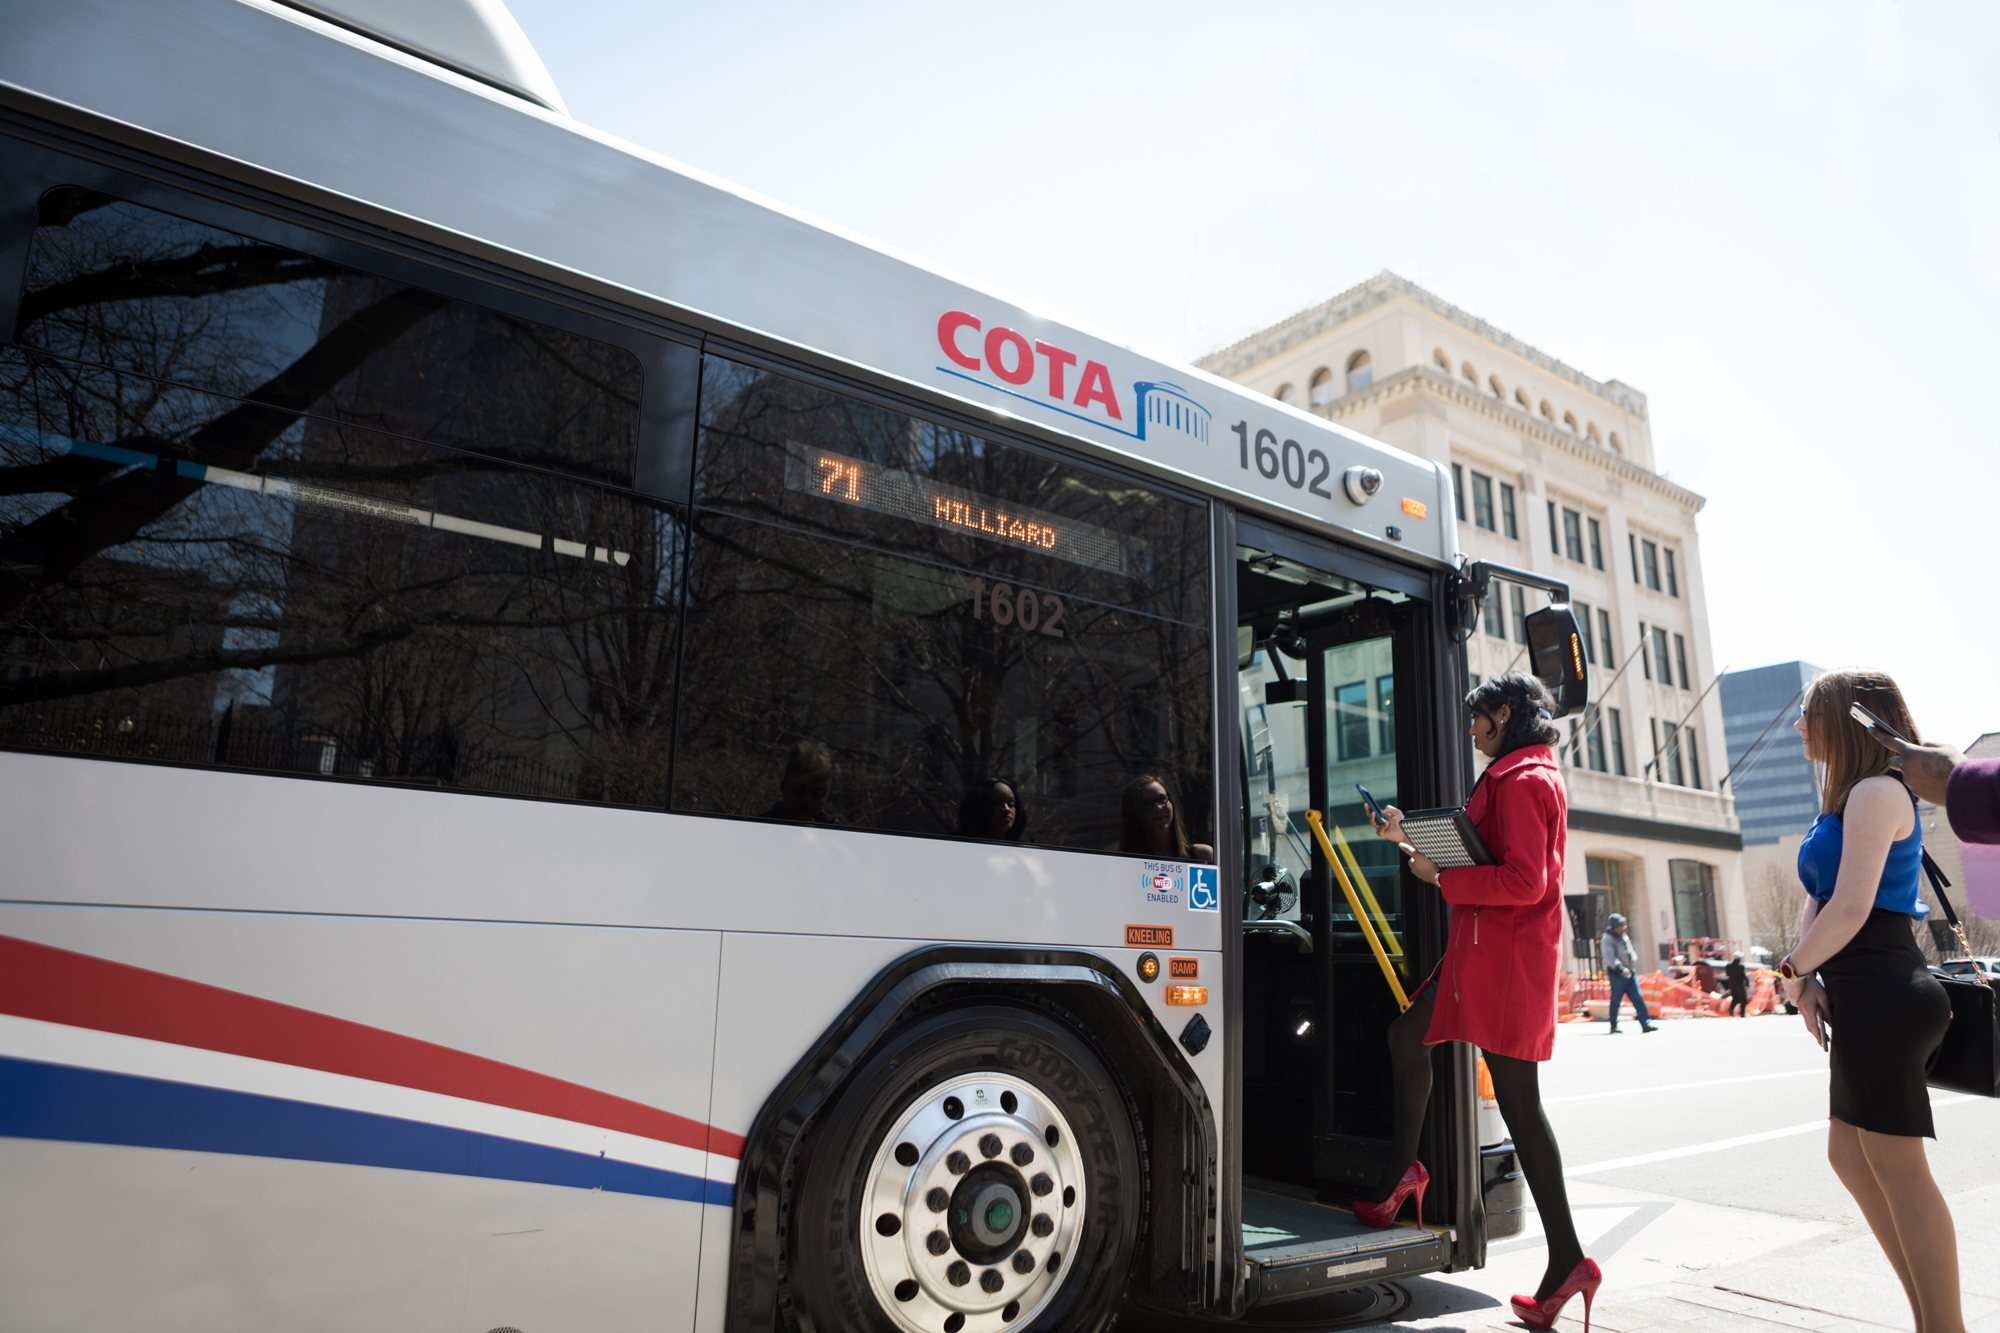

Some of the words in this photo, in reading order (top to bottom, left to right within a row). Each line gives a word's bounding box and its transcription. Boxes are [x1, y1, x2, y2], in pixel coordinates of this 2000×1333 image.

[936, 310, 1123, 421] COTA
[1231, 419, 1332, 500] 1602
[819, 456, 860, 502] 71
[935, 496, 1056, 549] HILLIARD
[965, 576, 1064, 638] 1602
[1144, 862, 1159, 872] THIS
[1161, 863, 1174, 873] BUS
[1175, 864, 1182, 873] IS
[1147, 893, 1179, 903] ENABLED
[1128, 928, 1171, 944] KNEELING
[1172, 962, 1196, 975] RAMP
[996, 1037, 1120, 1229] GOODYEAR
